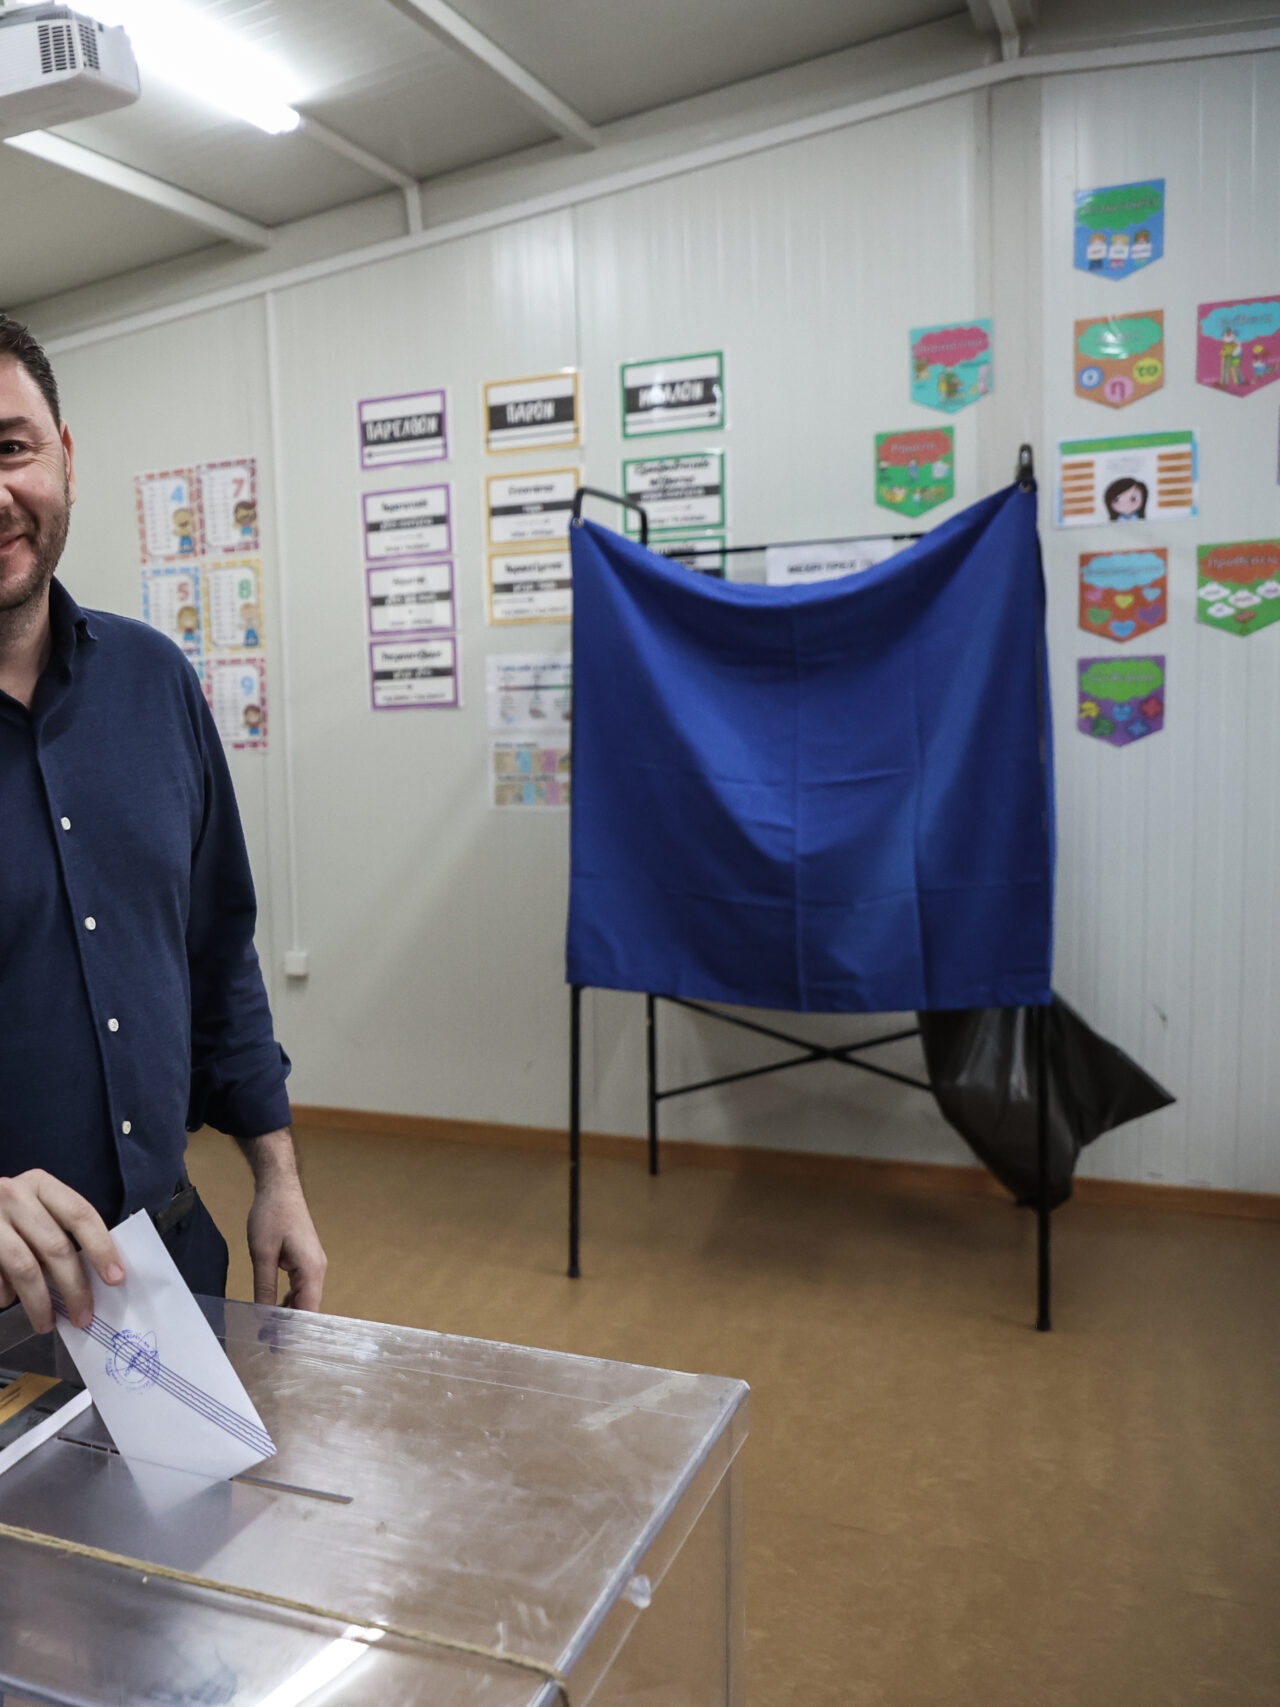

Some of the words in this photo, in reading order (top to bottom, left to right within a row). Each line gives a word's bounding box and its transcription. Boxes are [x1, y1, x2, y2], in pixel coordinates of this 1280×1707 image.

[171, 485, 185, 503] 4
[231, 478, 245, 499] 7
[177, 582, 190, 601] 5
[238, 579, 252, 600] 8
[241, 676, 255, 696] 9
